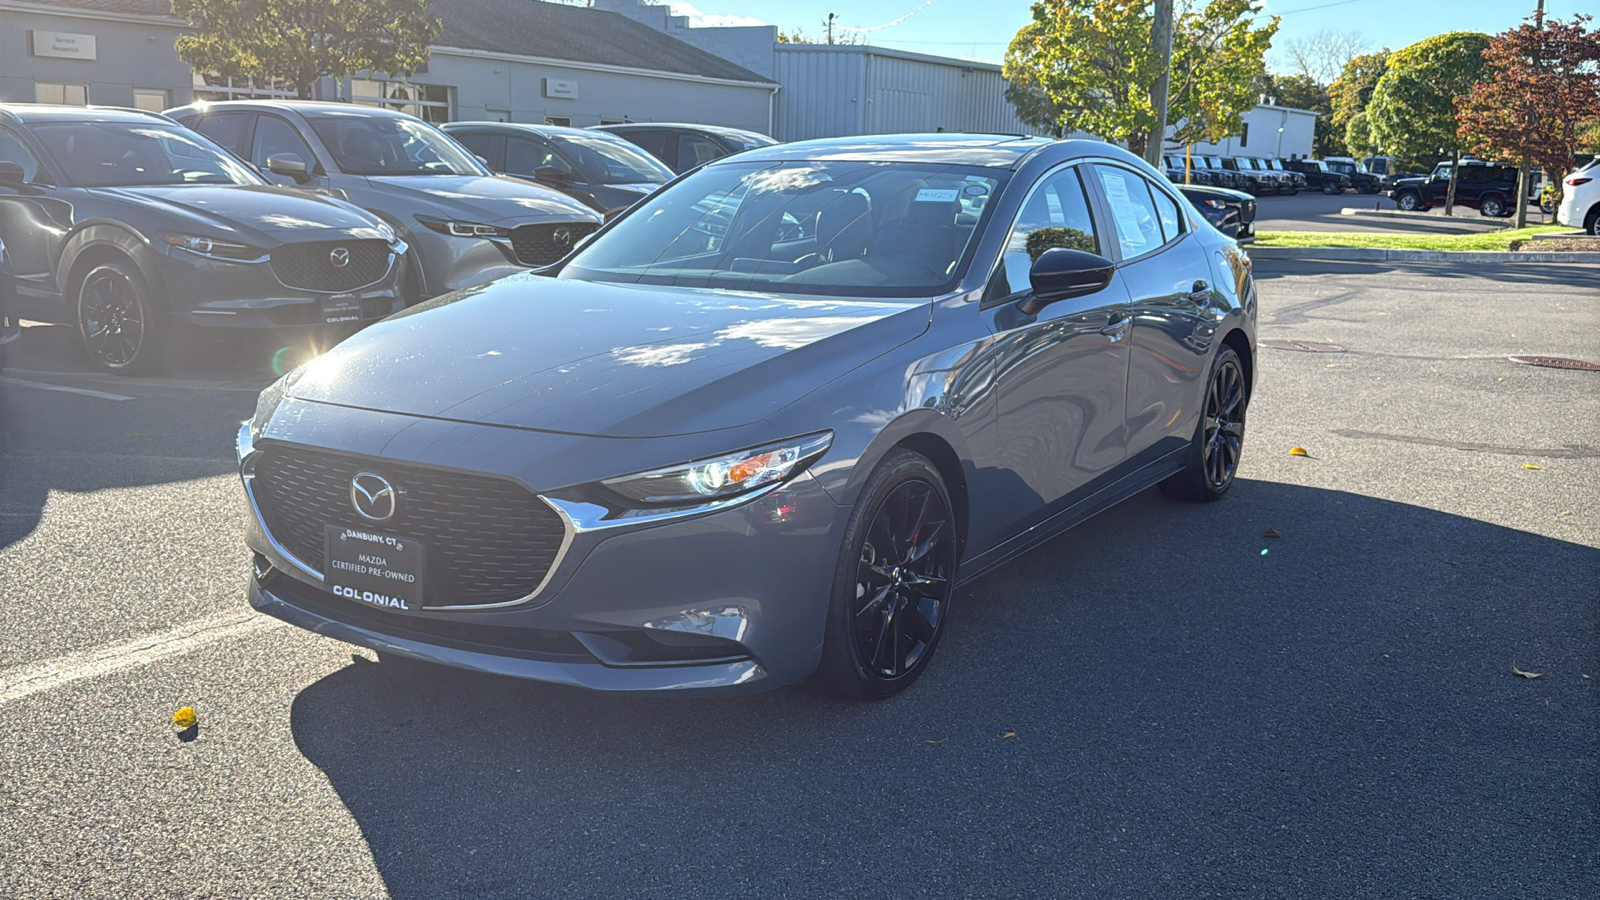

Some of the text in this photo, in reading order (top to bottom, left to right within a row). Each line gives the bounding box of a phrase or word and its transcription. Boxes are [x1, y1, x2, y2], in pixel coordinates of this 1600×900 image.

[52, 45, 79, 53] Reception
[326, 315, 359, 323] COLONIAL
[385, 537, 397, 546] CT
[358, 554, 387, 566] MAZDA
[332, 560, 415, 583] CERTIFIED PRE-OWNED
[333, 585, 409, 610] COLONIAL
